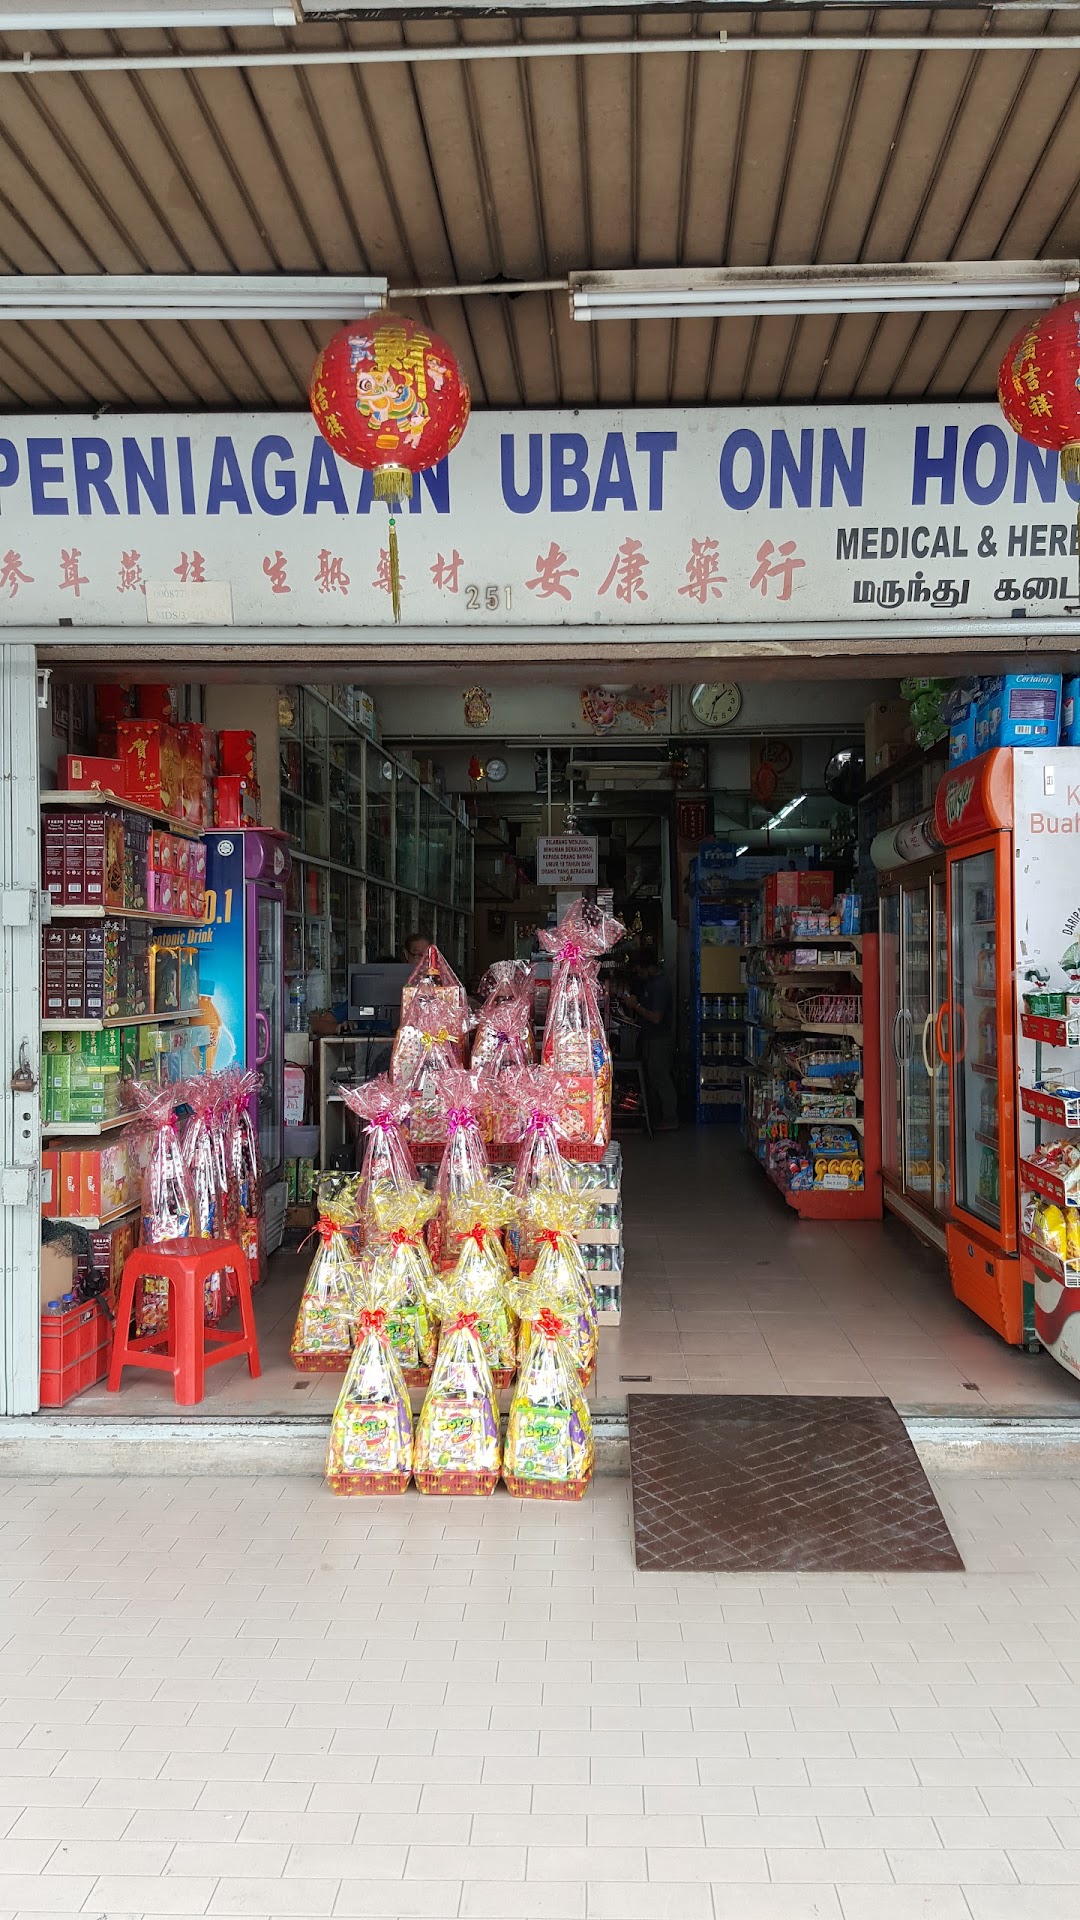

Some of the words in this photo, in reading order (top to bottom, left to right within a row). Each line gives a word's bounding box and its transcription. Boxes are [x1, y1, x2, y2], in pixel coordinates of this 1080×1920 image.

[501, 432, 677, 514] UBAT
[719, 427, 866, 511] ONN
[911, 424, 1080, 505] HON
[836, 526, 968, 560] MEDICAL
[977, 525, 998, 557] &
[466, 586, 512, 611] 251
[204, 888, 233, 924] O.1
[152, 931, 185, 947] sotonic
[187, 927, 214, 945] Drink
